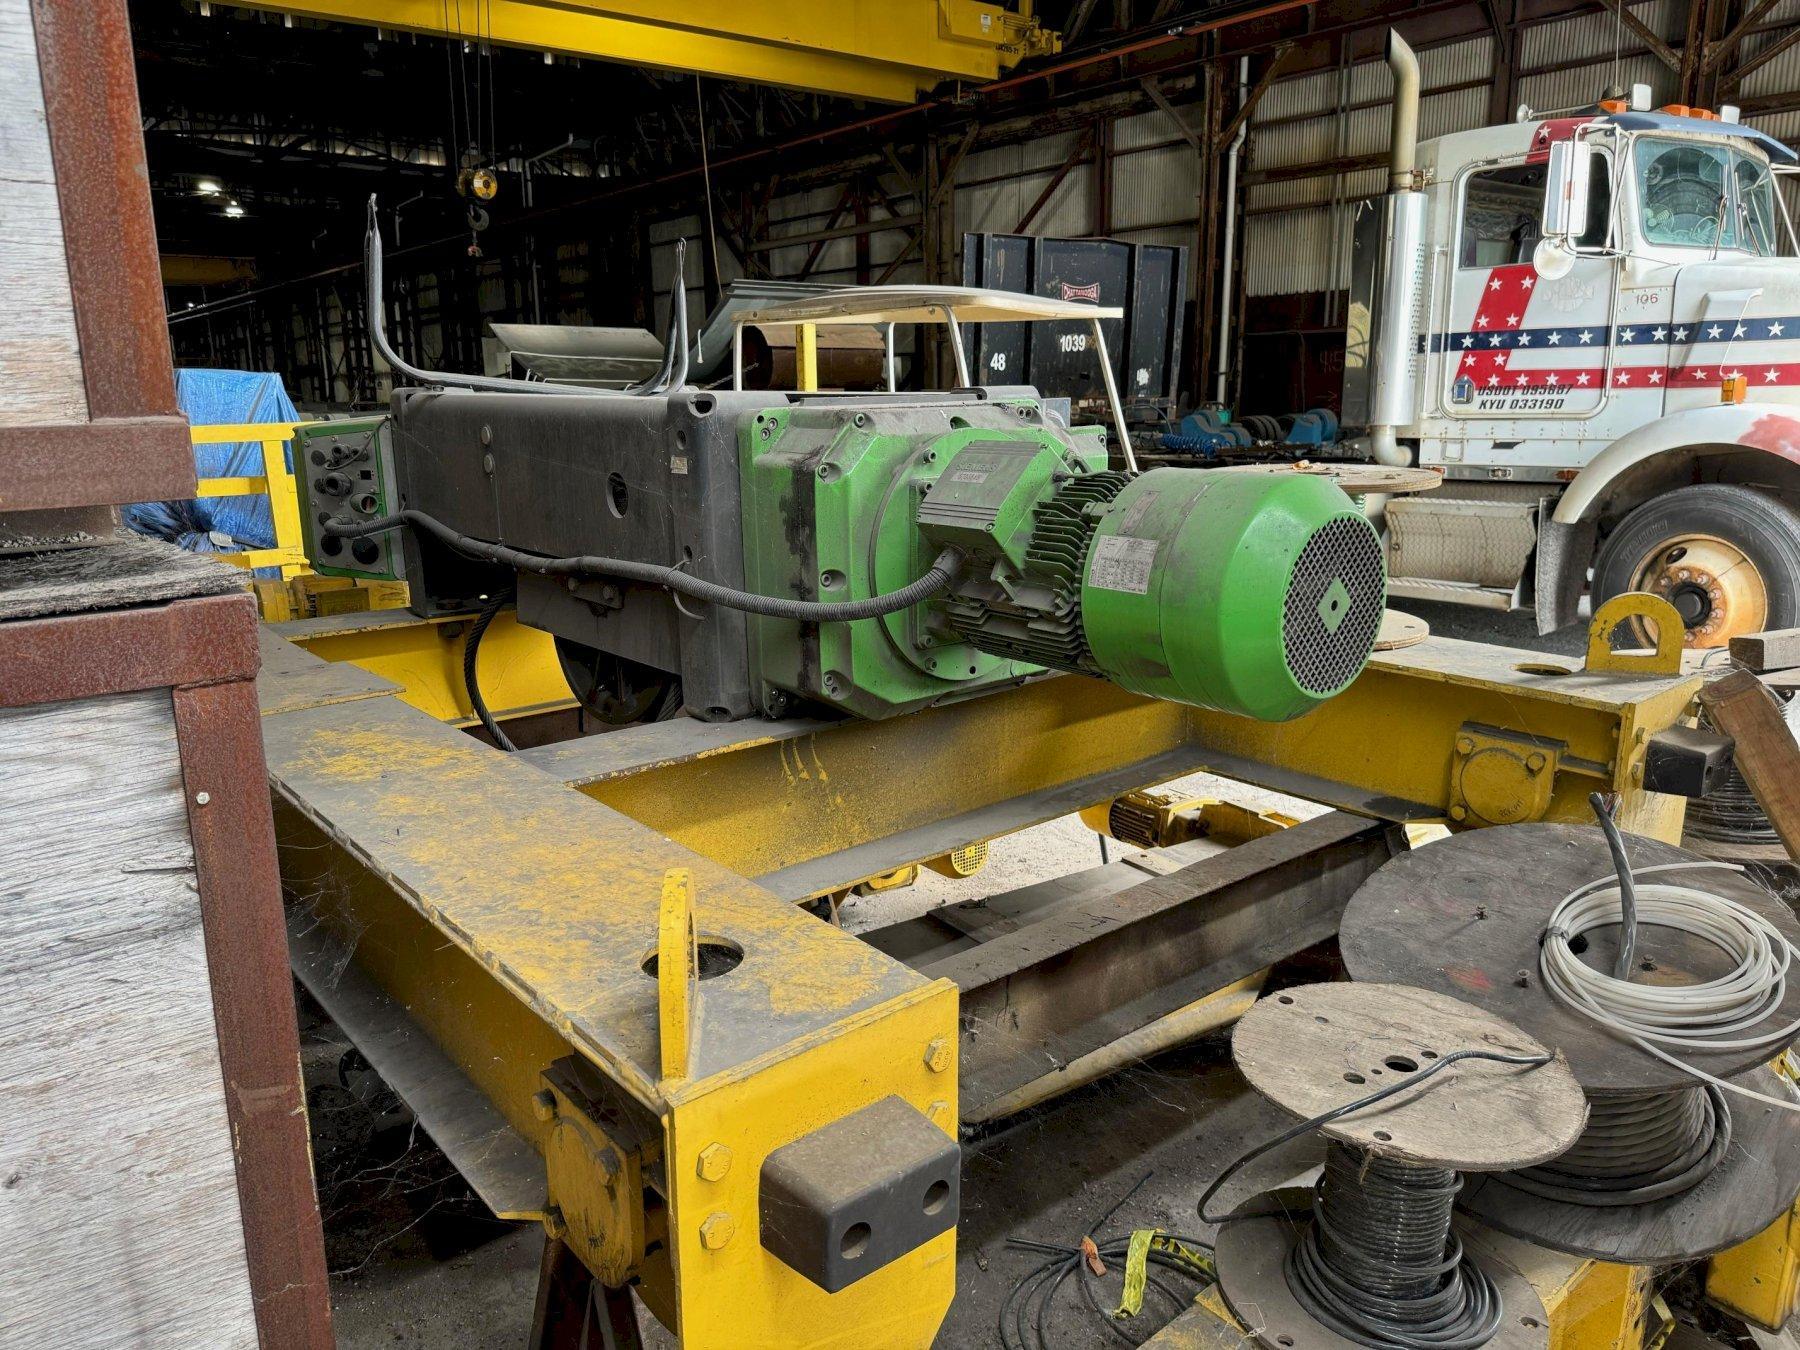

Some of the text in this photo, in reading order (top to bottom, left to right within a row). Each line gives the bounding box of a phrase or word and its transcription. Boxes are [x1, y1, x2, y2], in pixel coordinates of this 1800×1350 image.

[1635, 293, 1658, 305] 106
[1060, 333, 1086, 352] 1039
[990, 352, 1006, 371] 48
[1477, 385, 1519, 396] USDOT
[1479, 398, 1565, 410] KYU 033190
